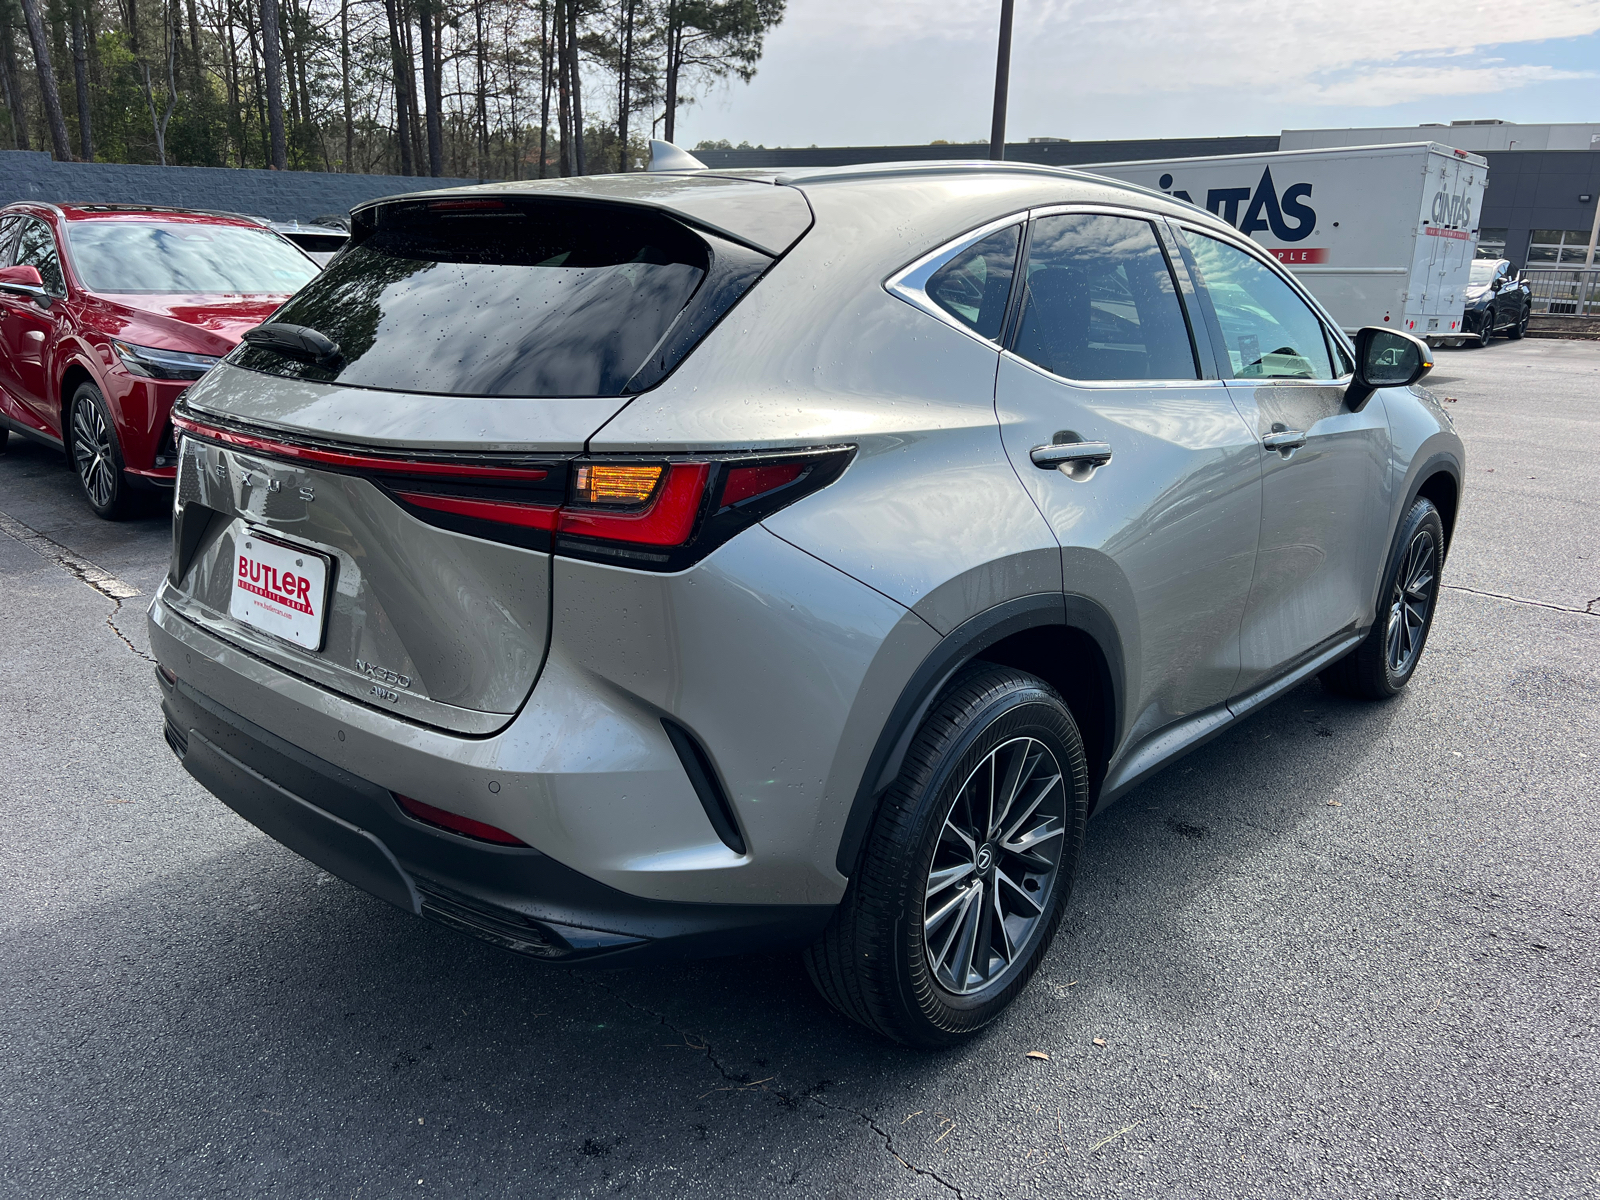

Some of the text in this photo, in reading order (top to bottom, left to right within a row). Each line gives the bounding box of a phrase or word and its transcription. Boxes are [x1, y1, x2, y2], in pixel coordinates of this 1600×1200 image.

[196, 458, 316, 502] LEXUS
[355, 658, 411, 688] NX350
[369, 685, 399, 704] AWD
